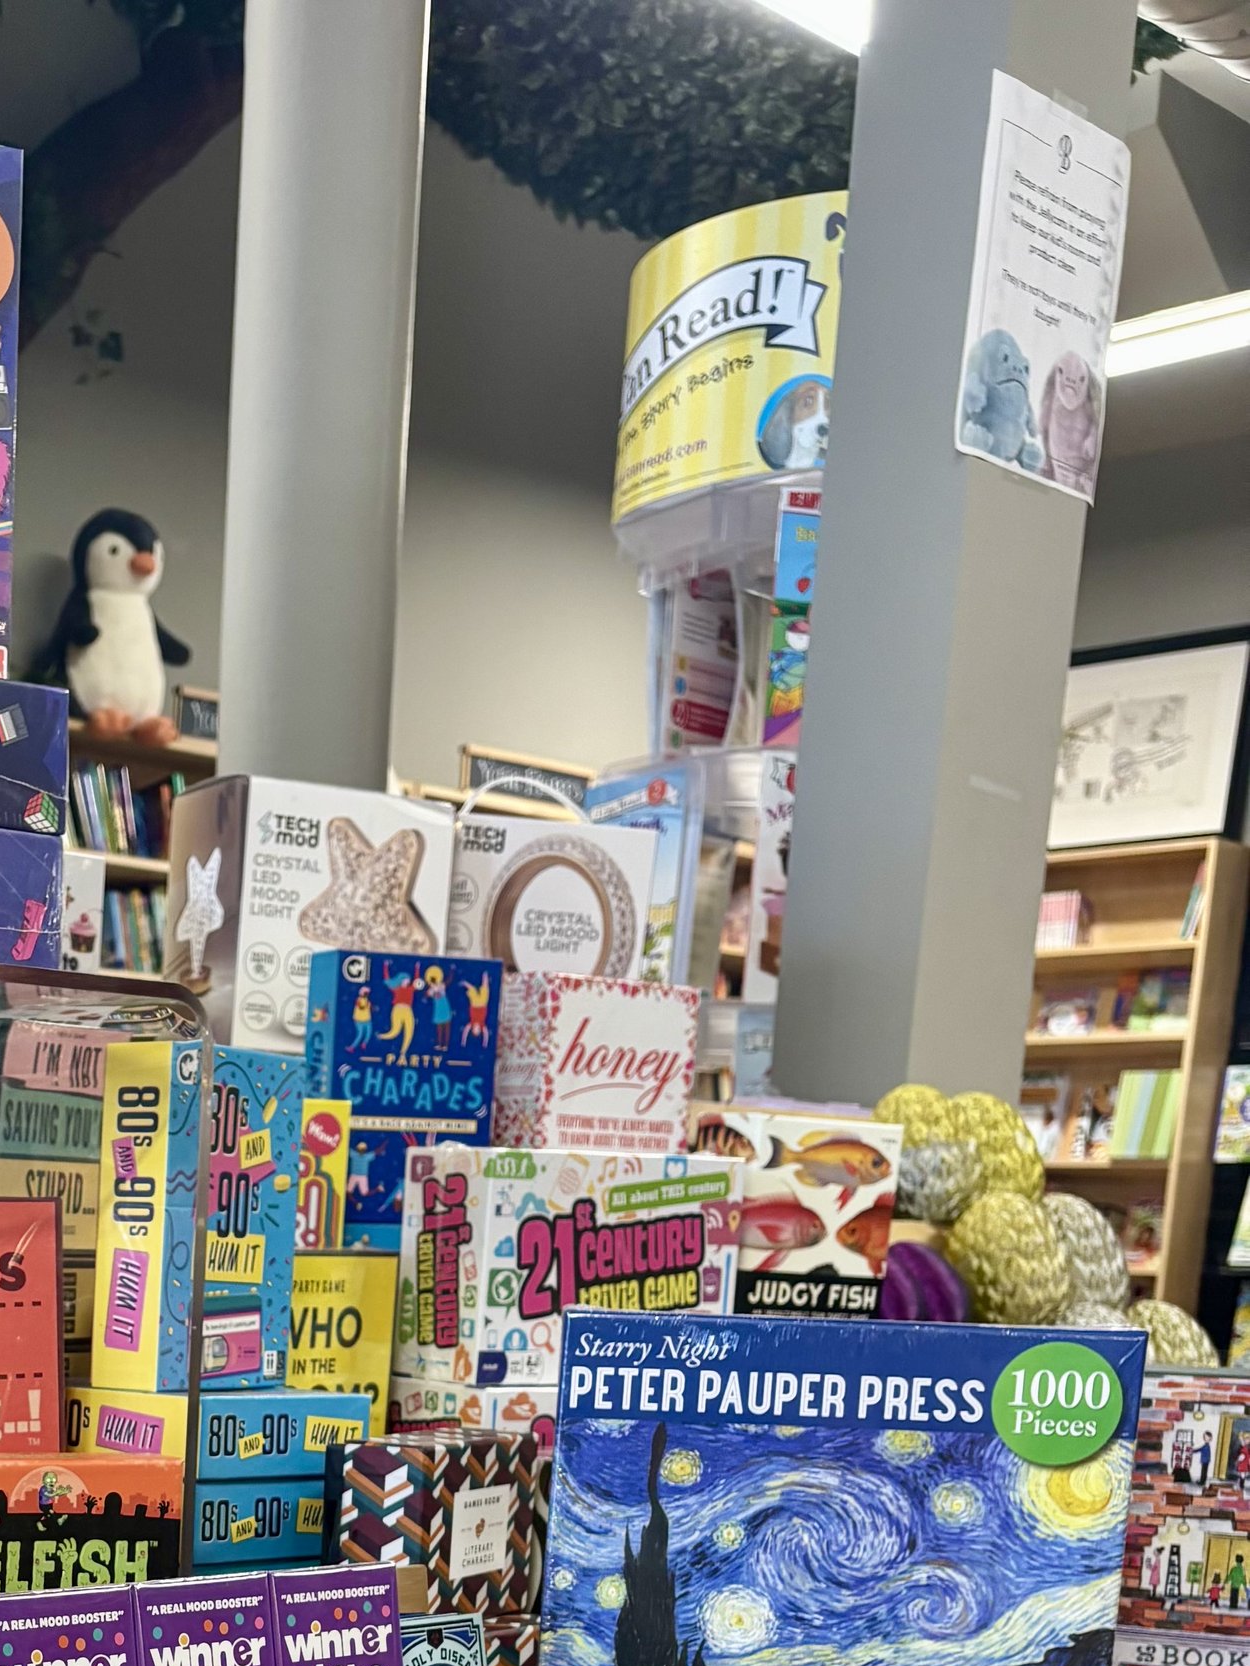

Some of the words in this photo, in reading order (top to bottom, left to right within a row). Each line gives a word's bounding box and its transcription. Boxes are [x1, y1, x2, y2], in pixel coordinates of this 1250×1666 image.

[657, 267, 785, 368] Read!
[274, 814, 321, 833] TECH
[463, 823, 507, 841] TECH
[252, 853, 322, 875] CRYSTAL
[252, 870, 281, 885] LED
[250, 904, 296, 920] LIGHT
[251, 887, 300, 904] MOOD
[524, 908, 596, 928] CRYSTAL
[385, 1054, 442, 1068] PARTY
[558, 1016, 682, 1124] honey
[342, 1065, 483, 1111] CHARADES
[2, 1097, 58, 1145] SAYING
[116, 1086, 161, 1149] 80s
[629, 1188, 659, 1205] about
[661, 1183, 686, 1199] THIS
[747, 1277, 827, 1310] JUDGY
[833, 1283, 878, 1311] FISH
[575, 1332, 652, 1363] Starry
[656, 1334, 733, 1367] Night
[569, 1364, 685, 1413] PETER
[697, 1371, 846, 1420] PAUPER
[857, 1377, 986, 1425] PRESS
[1008, 1367, 1111, 1411] 1000
[208, 1413, 246, 1457] 80s
[1011, 1408, 1098, 1440] Pieces
[464, 1542, 494, 1556] LITERARY
[283, 1619, 394, 1665] winner
